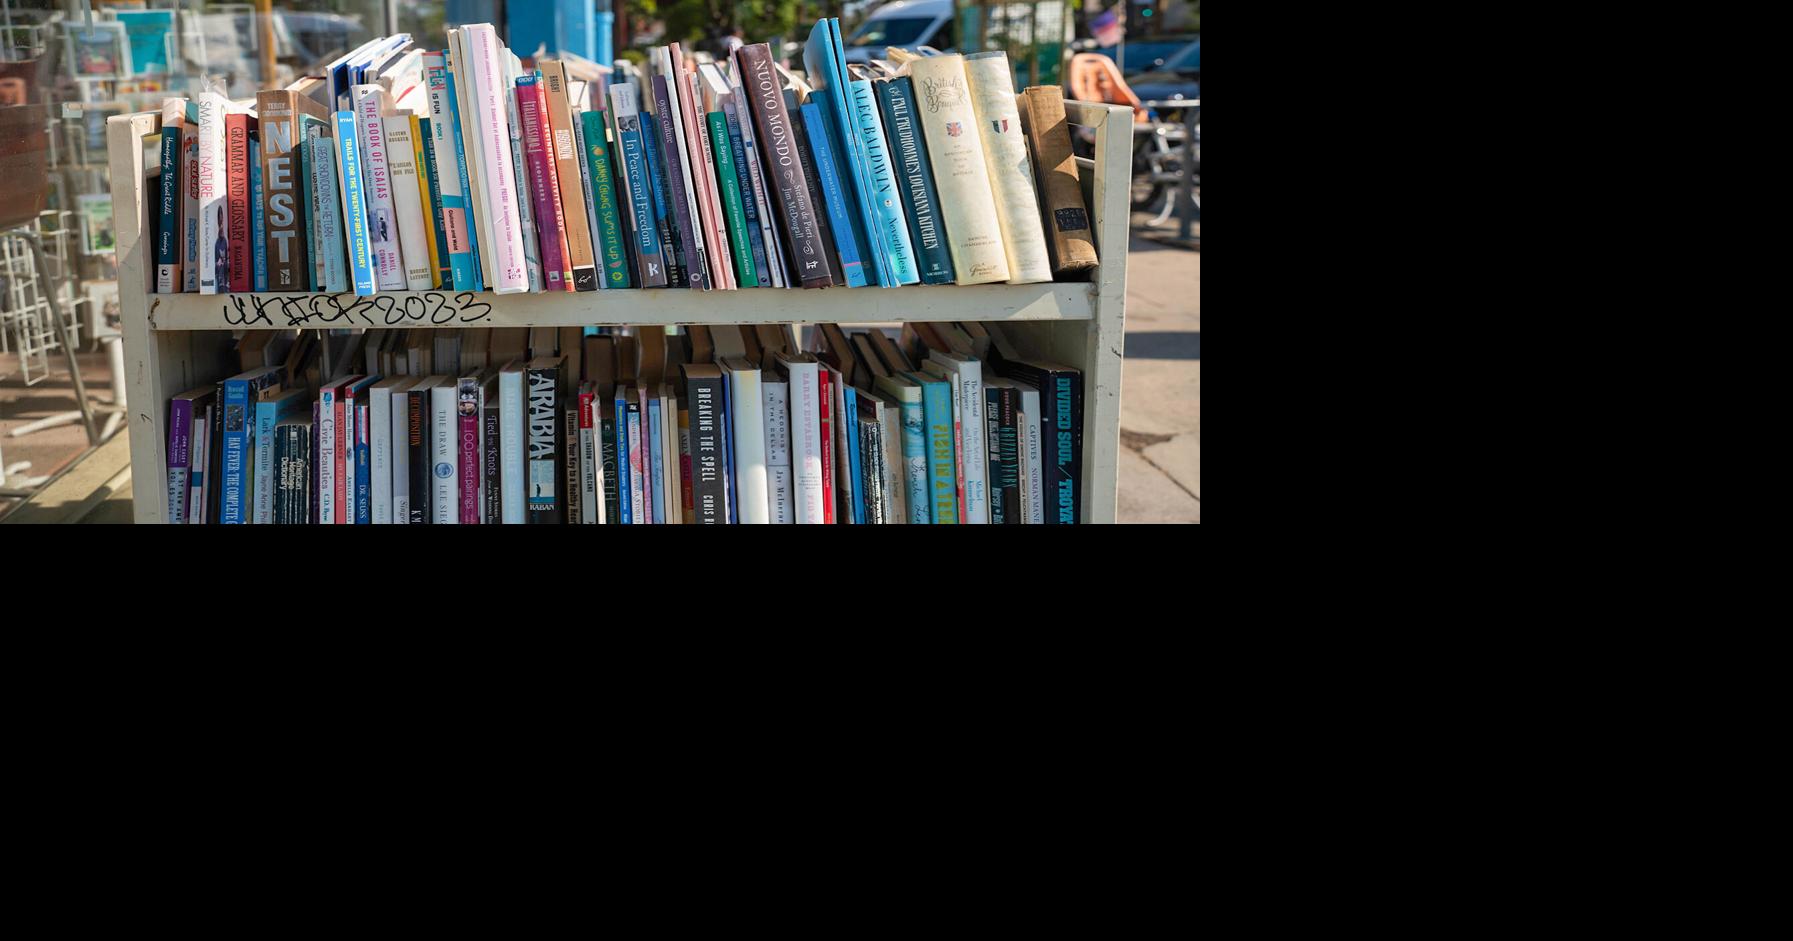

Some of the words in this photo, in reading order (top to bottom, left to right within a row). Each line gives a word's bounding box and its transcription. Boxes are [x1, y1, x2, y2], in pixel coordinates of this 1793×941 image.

[549, 76, 560, 93] BRIGHT
[921, 77, 959, 94] British
[366, 101, 377, 119] THE
[433, 100, 441, 114] FUN
[754, 59, 779, 110] NUOVO
[768, 114, 792, 167] MONDO
[891, 97, 907, 116] PAUL
[522, 101, 539, 147] ITALIANISSIMO
[658, 100, 669, 118] oyster
[664, 120, 674, 144] culture
[728, 114, 738, 130] ROHR
[368, 123, 381, 148] BOOK
[544, 124, 555, 167] BEGINNERS
[625, 139, 637, 150] In
[715, 121, 722, 129] As
[719, 145, 729, 164] Saying
[852, 86, 869, 124] ALEC
[864, 126, 891, 193] BALDWIN
[896, 116, 919, 174] PRUDHOMME'S
[162, 137, 174, 170] Homeopathy:
[232, 127, 244, 174] GRAMMAR
[318, 146, 328, 163] GREAT
[344, 138, 354, 160] TRAILS
[372, 152, 383, 163] OF
[733, 136, 746, 174] BREATHING
[165, 173, 173, 181] The
[200, 156, 213, 198] NATURE
[347, 162, 356, 176] FOR
[594, 158, 608, 182] DANNY
[626, 152, 641, 179] Peace
[164, 182, 173, 196] Great
[232, 176, 244, 197] AND
[265, 122, 295, 263] NEST
[349, 176, 358, 189] THE
[374, 167, 388, 199] ISAIAS
[536, 160, 545, 202] BEGINNERS
[549, 170, 560, 209] ACTIVITY
[632, 180, 647, 200] and
[740, 175, 750, 196] UNDER
[822, 158, 835, 195] UNDERWATER
[832, 196, 843, 219] MUSEUM
[163, 198, 172, 215] Riddle
[598, 184, 611, 209] CHUNG
[743, 196, 754, 219] WATER
[780, 188, 793, 201] Jim
[794, 184, 807, 211] Stefano
[910, 175, 928, 214] LOUISIANA
[232, 200, 245, 242] GLOSSARY
[322, 211, 333, 238] RETURN
[350, 191, 364, 237] TWENTY-FIRST
[603, 212, 616, 235] SUMS
[634, 202, 653, 247] Freedom
[785, 203, 804, 239] McDougall
[802, 212, 809, 220] de
[608, 236, 617, 244] IT
[728, 184, 736, 207] Collection
[732, 211, 741, 228] Favorite
[742, 258, 750, 276] Articles
[804, 221, 814, 238] Pieri
[920, 214, 939, 250] KITCHEN
[356, 238, 367, 269] CENTURY
[608, 246, 618, 260] UP
[888, 218, 908, 275] Nevertheless
[379, 250, 388, 276] CONNOLLY
[388, 252, 397, 271] DANIEL
[768, 393, 774, 402] IN
[802, 372, 810, 408] BARRY
[962, 380, 970, 410] Masterpiece
[698, 388, 712, 431] BREAKING
[988, 402, 999, 419] PLEASE
[1056, 377, 1072, 430] DIVIDED
[262, 418, 271, 434] Lark
[410, 396, 422, 446] DECOMPOSITION
[438, 410, 446, 427] THE
[487, 416, 498, 435] Tied
[529, 374, 555, 460] ARABIA
[568, 412, 577, 436] Vitamin
[228, 438, 241, 450] HAY
[321, 419, 334, 445] Civic
[439, 431, 447, 456] DRAW
[464, 430, 474, 451] 100
[700, 436, 714, 451] THE
[933, 424, 951, 459] FISH
[988, 420, 1000, 452] UNDERSTAND
[1000, 428, 1017, 462] GRIZZLY
[1029, 424, 1037, 460] CAPTIVES
[261, 442, 270, 471] Termite
[990, 453, 1000, 462] ME
[1057, 431, 1073, 466] SOUL
[227, 451, 241, 473] FEVER:
[279, 456, 289, 490] Dictionary
[296, 458, 304, 490] American
[321, 448, 334, 490] Beauties
[463, 452, 474, 479] perfect
[488, 448, 498, 476] Knots
[568, 458, 578, 469] Key
[603, 442, 616, 501] MACBETH
[702, 456, 715, 482] SPELL
[936, 463, 951, 477] IN
[226, 473, 240, 486] THE
[260, 475, 269, 491] Jayne
[287, 461, 296, 490] Heritage
[776, 471, 784, 482] Jay
[910, 458, 926, 497] French
[936, 480, 949, 490] A
[1000, 463, 1019, 488] YEARS
[225, 486, 240, 520] COMPLETE
[260, 494, 269, 509] Anne
[463, 480, 475, 510] pairings
[568, 484, 578, 507] Healthy
[703, 494, 714, 515] CHRIS
[991, 487, 1002, 507] Keirsey
[1058, 478, 1074, 524] TROYA
[398, 500, 408, 524] Singer
